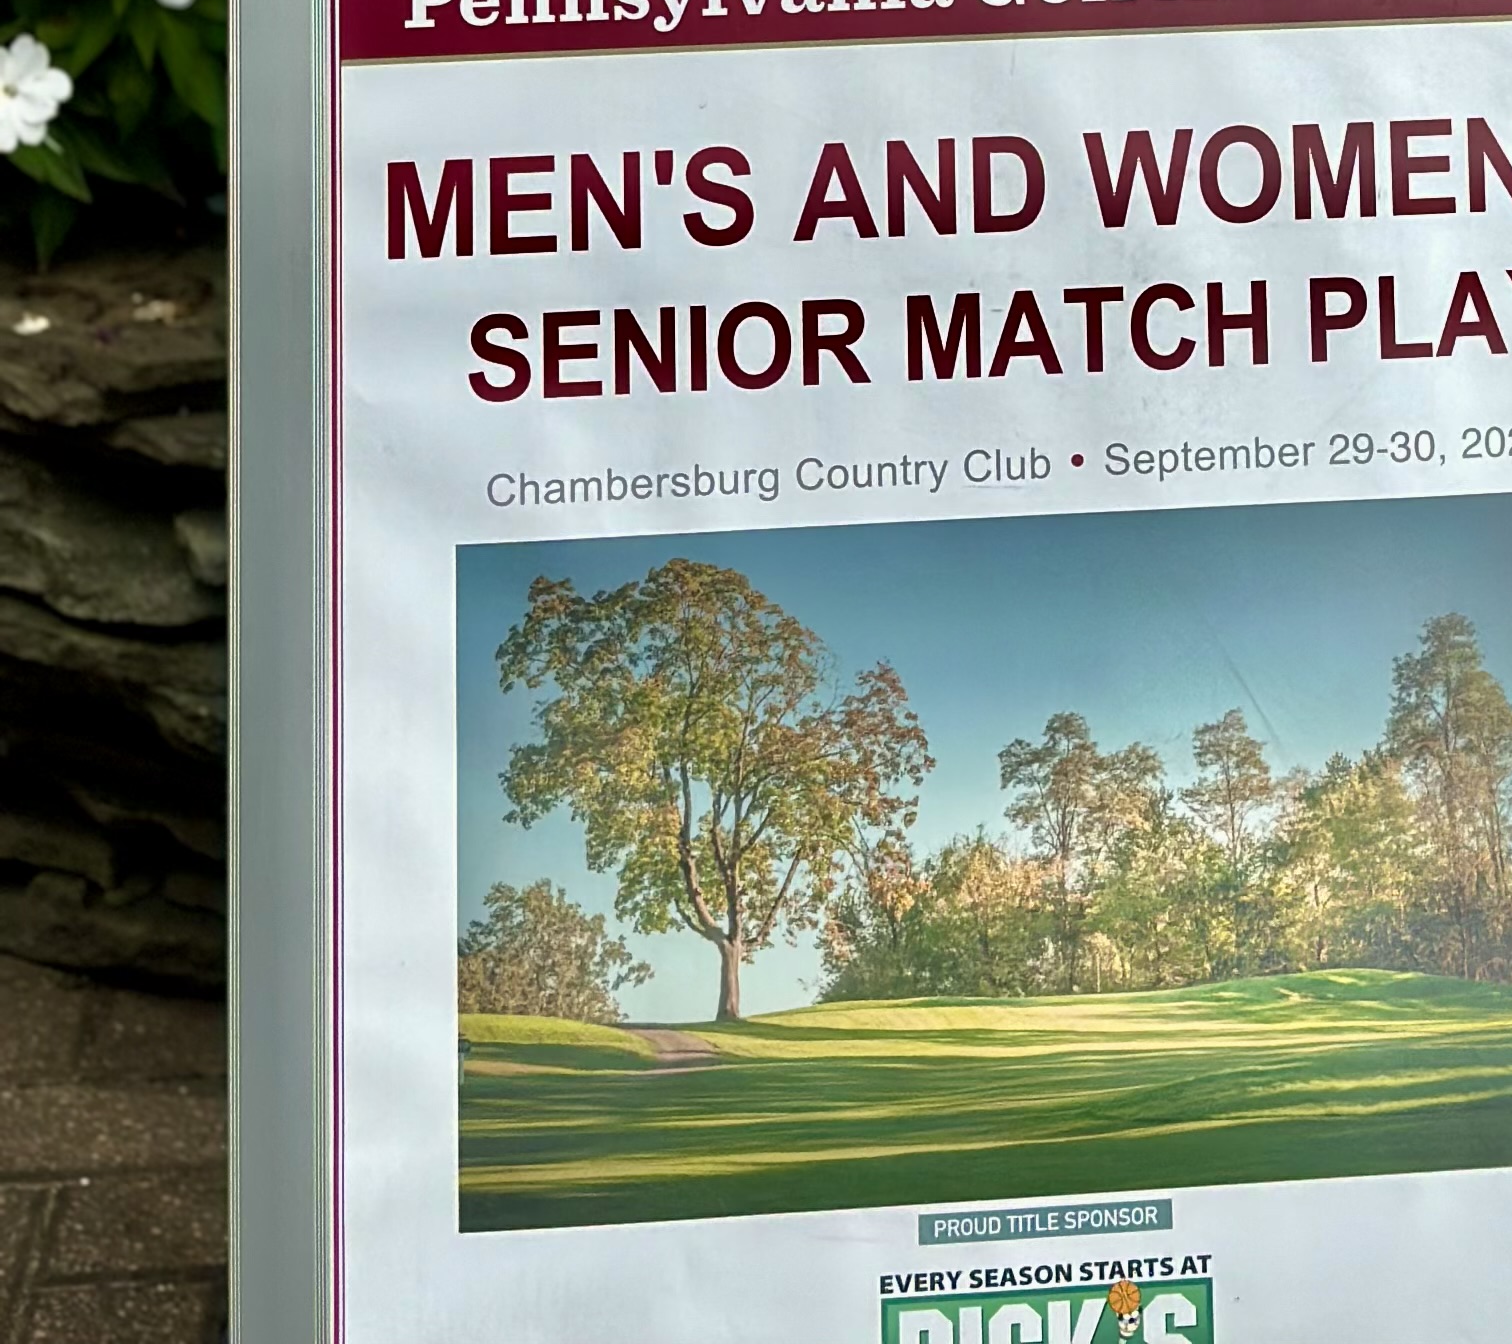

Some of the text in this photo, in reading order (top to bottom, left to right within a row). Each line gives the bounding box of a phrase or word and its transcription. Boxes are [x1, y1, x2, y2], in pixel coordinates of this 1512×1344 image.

[388, 147, 754, 259] MEN'S
[794, 136, 1045, 241] AND
[469, 299, 871, 402] SENIOR
[907, 280, 1268, 381] MATCH
[487, 464, 778, 506] Chambersburg
[797, 455, 948, 493] Country
[964, 447, 1050, 482] Club
[1105, 437, 1315, 481] September
[1330, 430, 1445, 465] 29-30,
[933, 1207, 1158, 1238] PROUD TITLE SPONSOR
[881, 1255, 1211, 1294] EVERY SEASON STARTS AT
